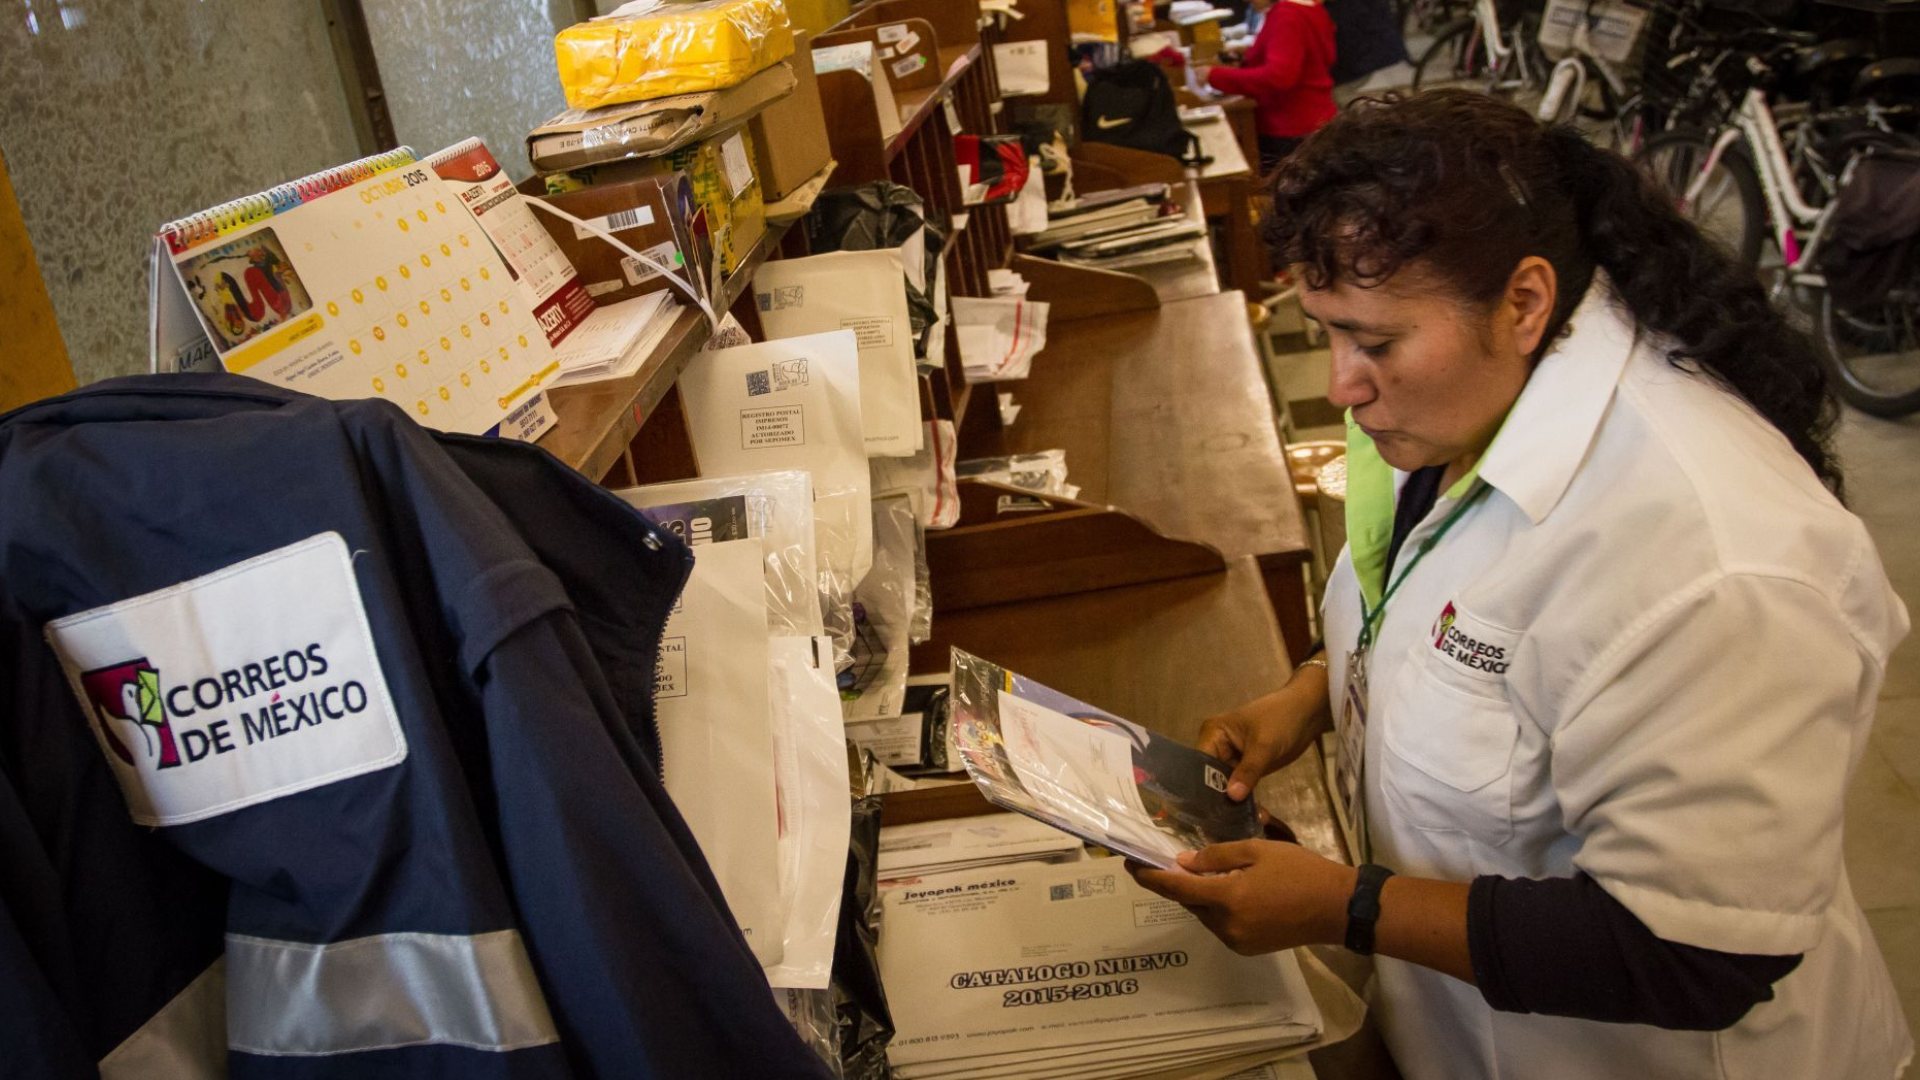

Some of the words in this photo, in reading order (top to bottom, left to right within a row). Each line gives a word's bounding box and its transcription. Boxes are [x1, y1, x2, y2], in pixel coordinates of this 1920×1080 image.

[402, 168, 429, 188] 2015
[741, 411, 775, 419] REGISTRO
[776, 409, 800, 417] POSTAL
[751, 430, 795, 438] AUTORIZADO
[1442, 639, 1455, 658] DE
[1448, 626, 1505, 660] CORREOS
[166, 643, 328, 718] CORREOS
[180, 720, 236, 763] DE
[240, 680, 368, 746] MÉXICO
[951, 961, 1091, 990] CATALOGO
[1095, 951, 1188, 976] NUEVO
[1003, 978, 1140, 1008] 2015-2016
